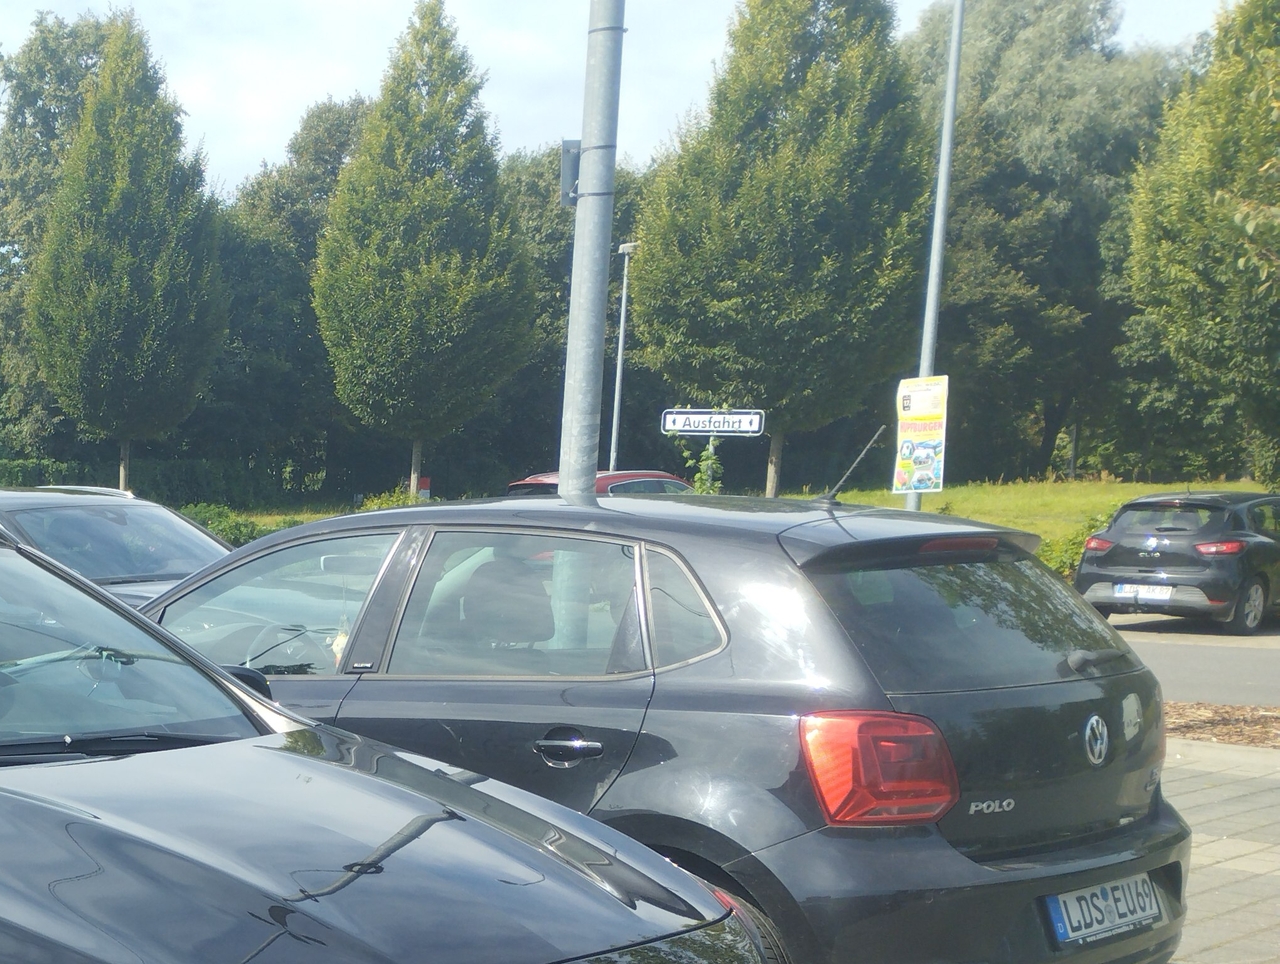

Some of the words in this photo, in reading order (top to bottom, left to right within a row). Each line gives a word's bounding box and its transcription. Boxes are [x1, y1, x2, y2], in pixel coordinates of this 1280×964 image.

[682, 416, 742, 429] Ausfahrt
[968, 798, 1015, 815] POLO
[1062, 892, 1105, 933] LDS
[1057, 923, 1064, 933] D
